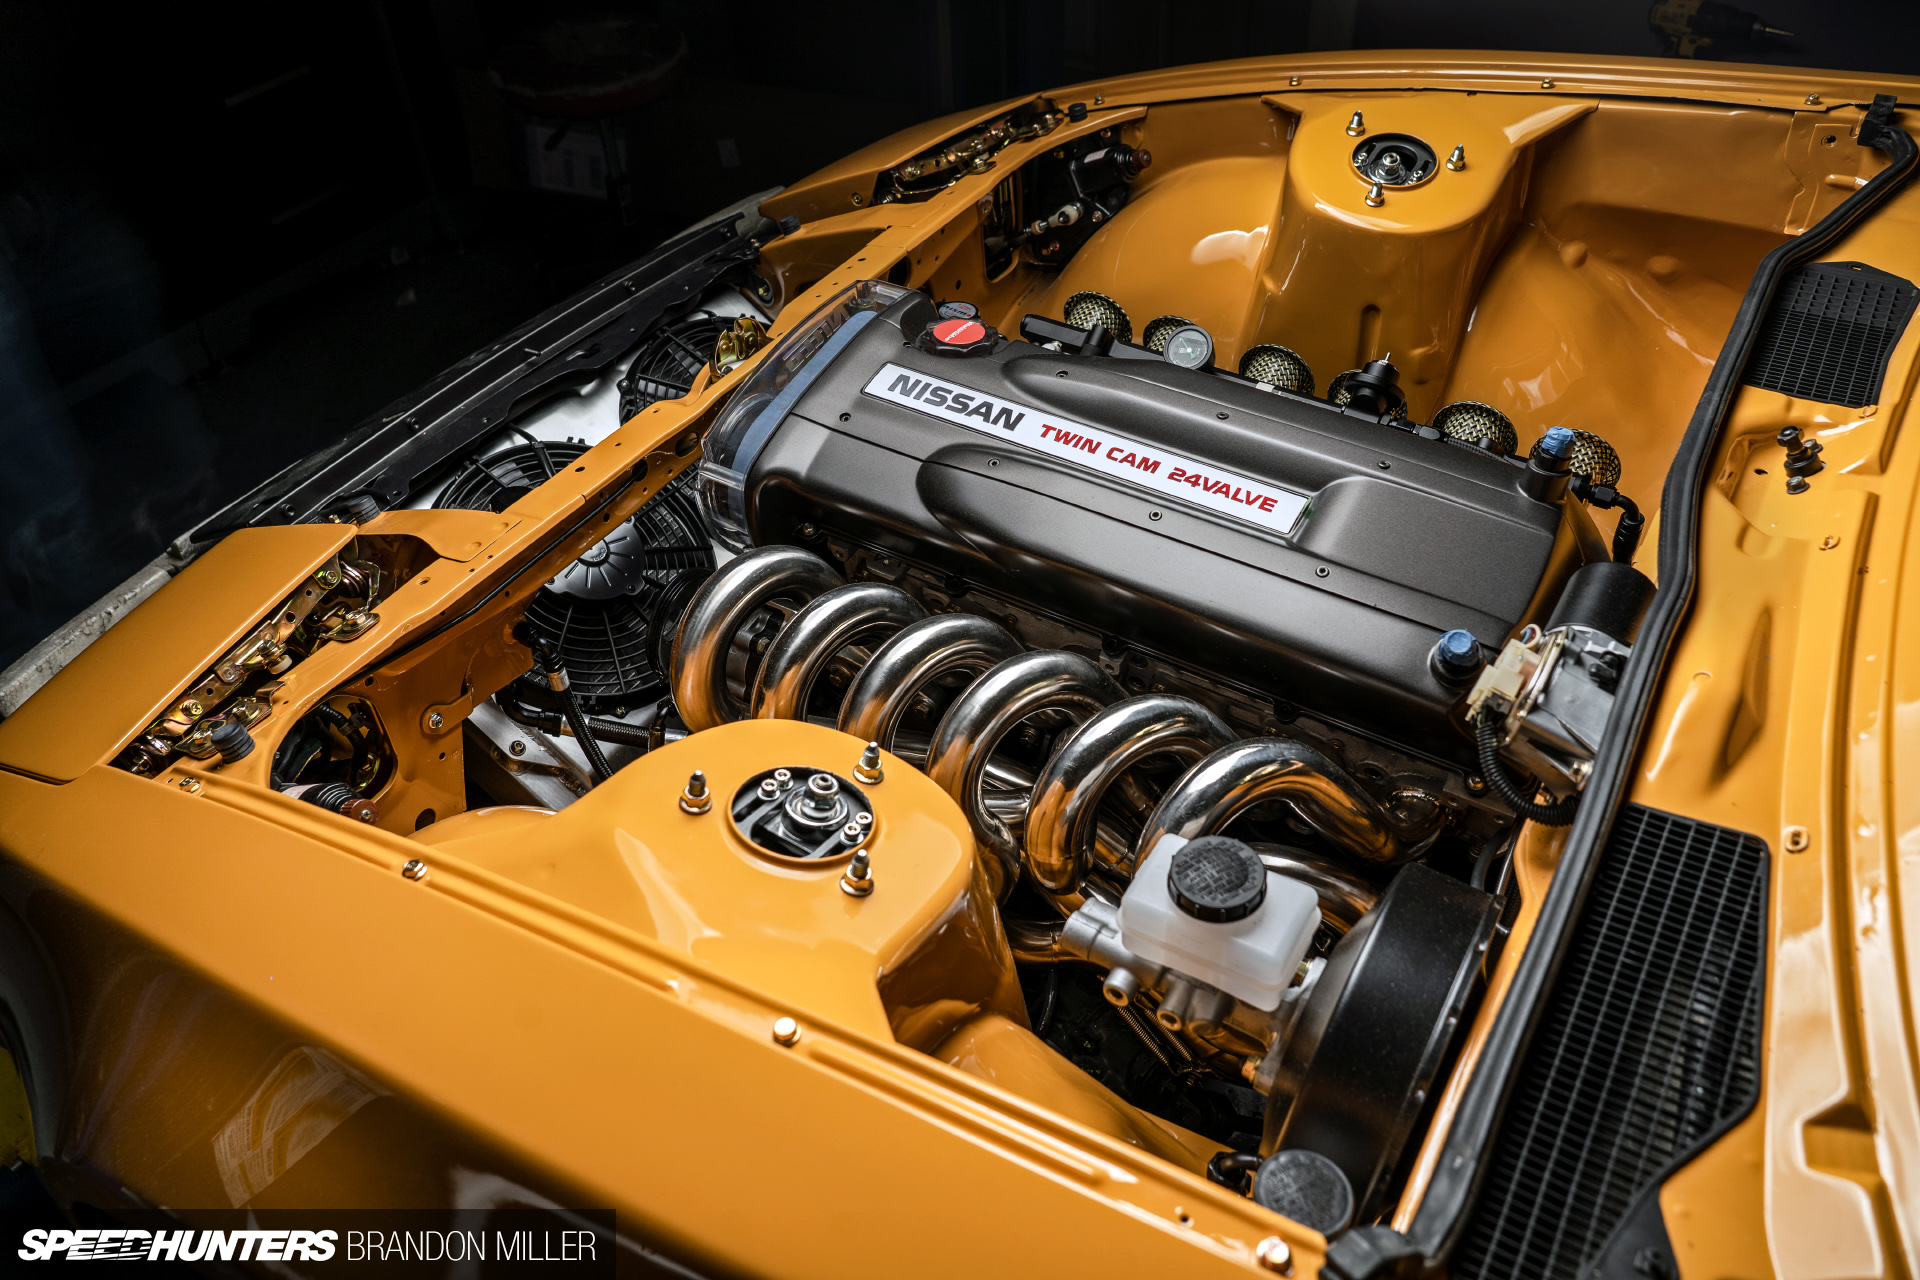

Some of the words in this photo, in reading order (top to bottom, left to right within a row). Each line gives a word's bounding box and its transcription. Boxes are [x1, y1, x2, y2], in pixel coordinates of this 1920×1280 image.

[887, 373, 1026, 432] NISSAN
[1040, 423, 1102, 454] TWIN
[1105, 447, 1161, 474] CAM
[1167, 467, 1278, 513] 24VALVE
